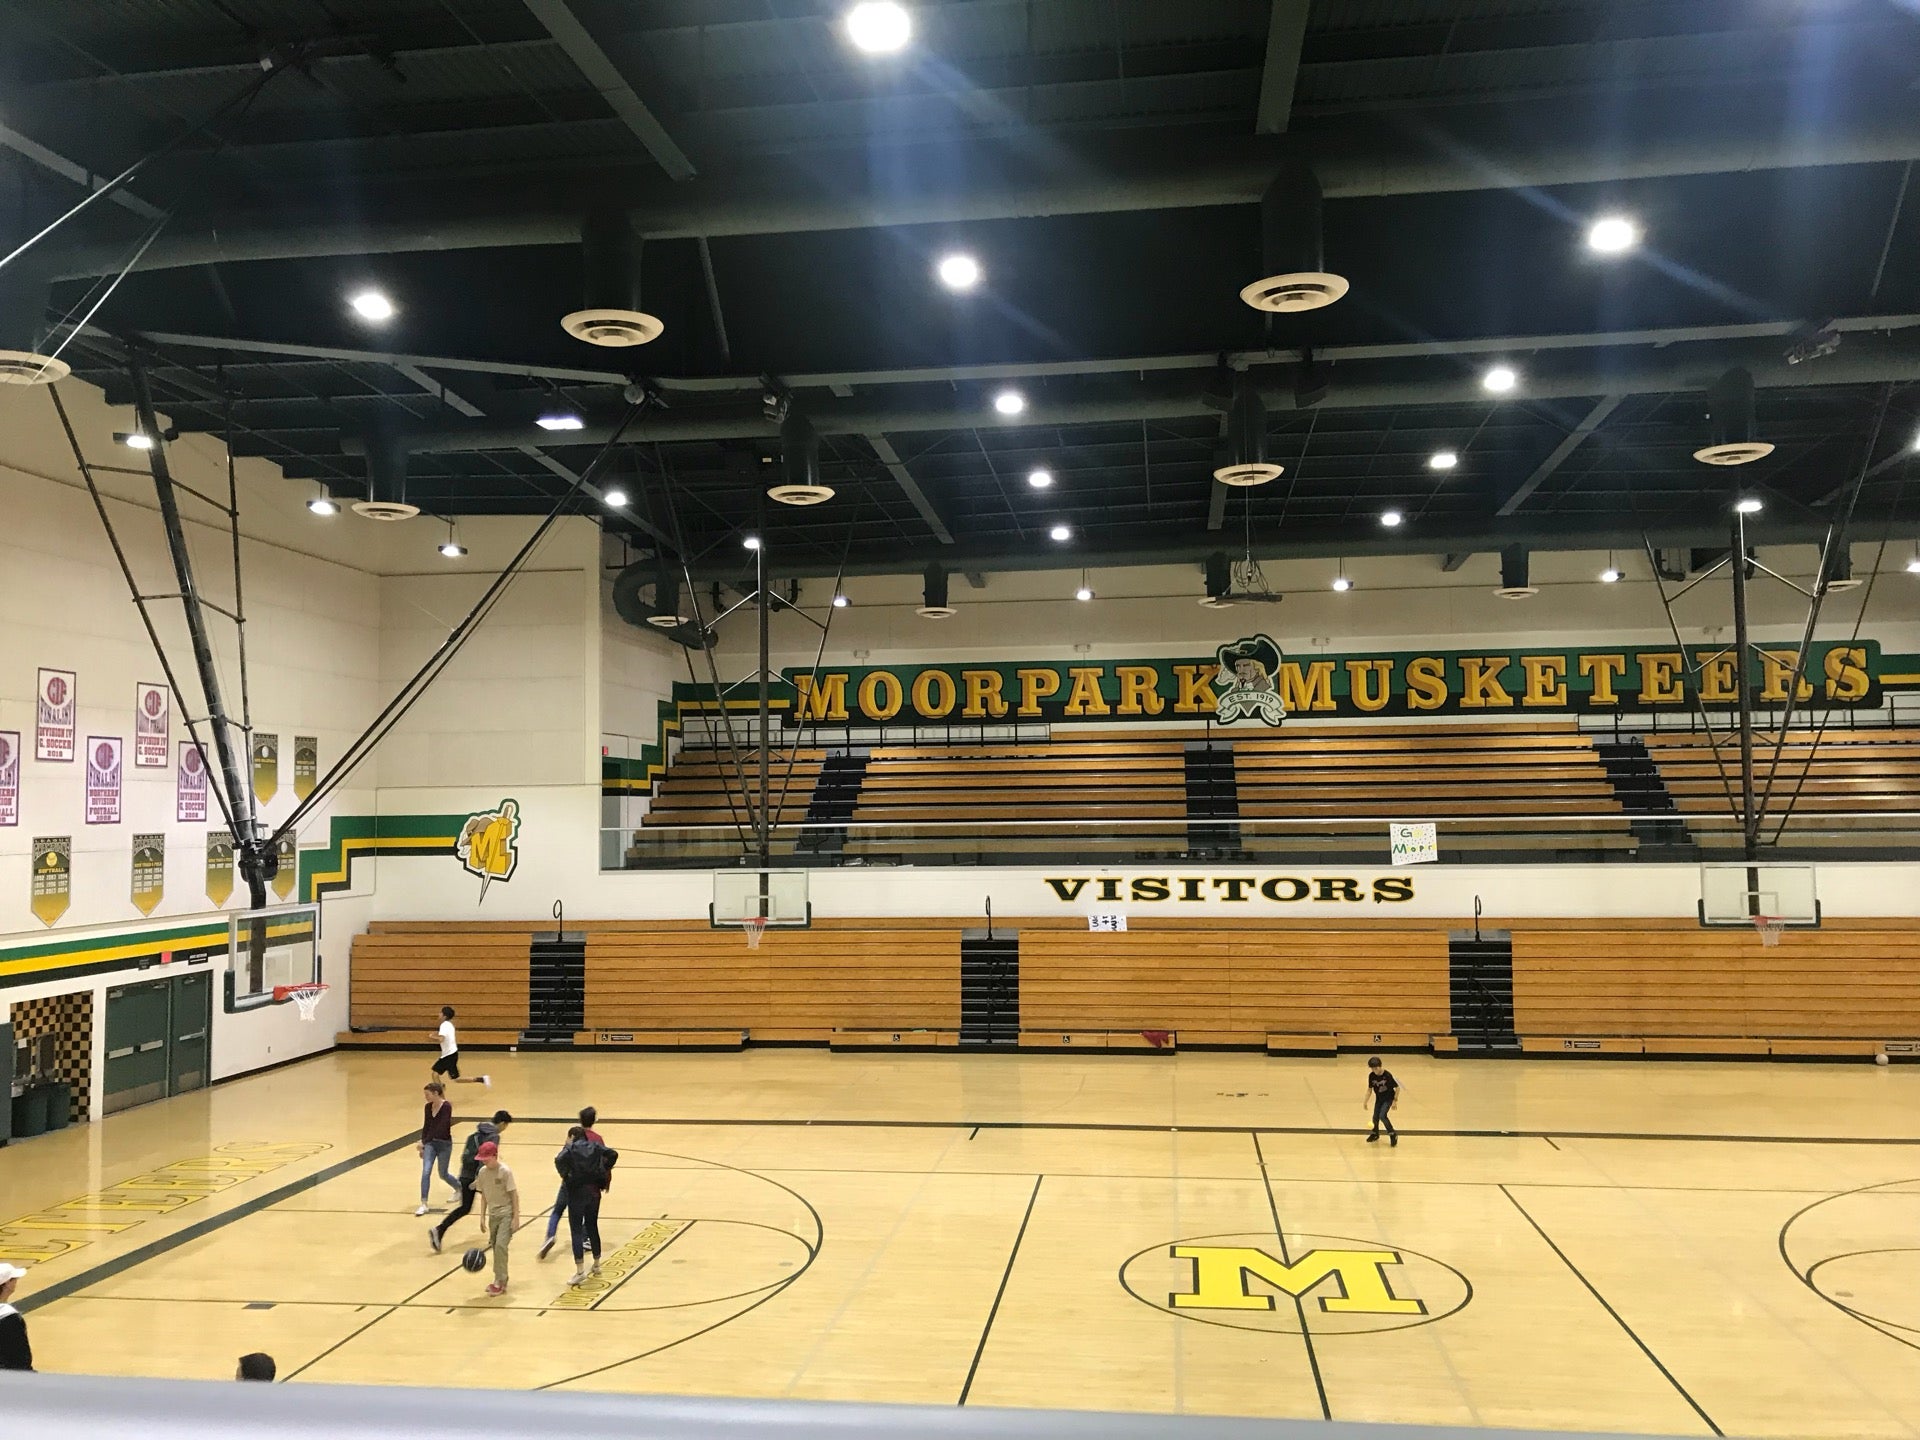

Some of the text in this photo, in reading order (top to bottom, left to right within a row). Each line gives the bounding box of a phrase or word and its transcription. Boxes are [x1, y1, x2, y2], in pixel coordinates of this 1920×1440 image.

[793, 647, 1870, 721] MOORPARK MUSKETEERS
[1228, 693, 1274, 704] EST. 1919
[1044, 877, 1415, 902] VISITORS
[1168, 1245, 1429, 1316] M
